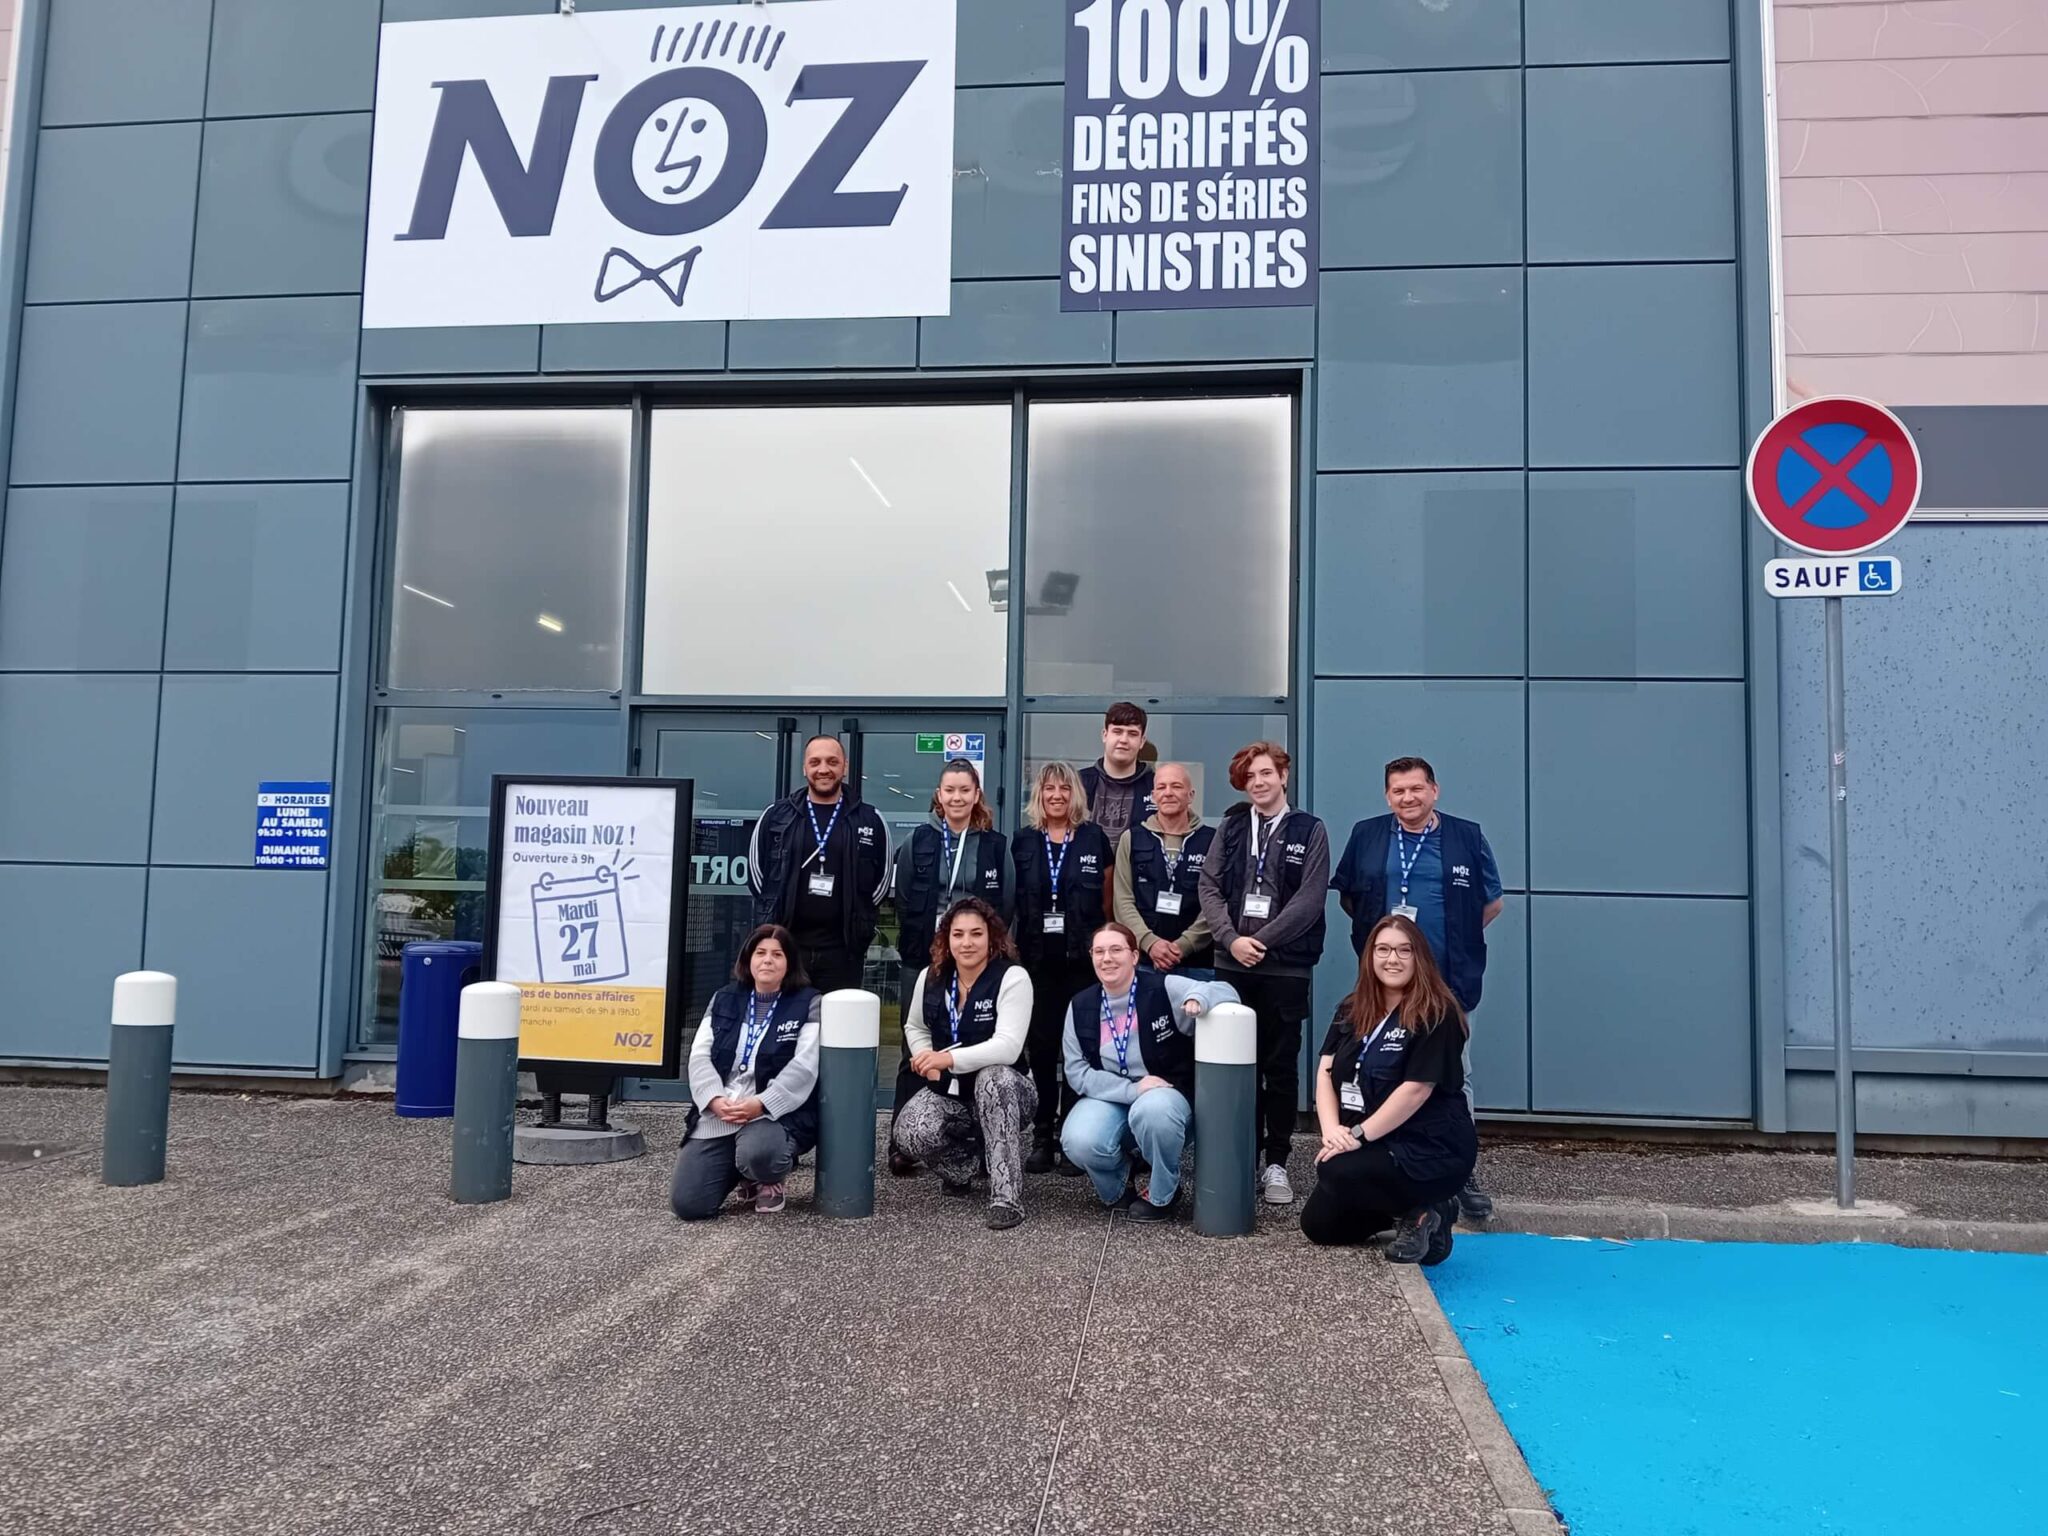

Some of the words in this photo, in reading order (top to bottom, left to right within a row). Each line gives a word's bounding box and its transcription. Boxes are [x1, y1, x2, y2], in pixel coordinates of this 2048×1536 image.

[1074, 0, 1310, 99] 100%
[1073, 98, 1309, 171] DÉGRIFFÉS
[393, 58, 929, 241] NOZ
[1072, 181, 1142, 225] FINS
[1150, 180, 1189, 223] DE
[1196, 171, 1309, 222] SÉRIES
[1068, 227, 1309, 294] SINISTRES
[1774, 566, 1850, 588] SAUF
[275, 796, 327, 804] HORAIRES
[515, 795, 589, 817] Nouveau
[261, 817, 278, 828] AU
[281, 818, 323, 828] SAMEDI
[276, 807, 310, 817] LUNDI
[257, 828, 283, 837] 9h30
[295, 829, 327, 838] 19h30
[514, 824, 587, 846] magasin
[592, 825, 624, 845] NOZ
[262, 845, 320, 855] DIMANCHE
[512, 852, 569, 864] Ouverture
[580, 854, 595, 864] 9h
[558, 901, 599, 922] Mardi
[559, 922, 599, 961] 27
[573, 960, 597, 978] mai
[537, 988, 551, 999] de
[553, 989, 593, 1001] bonnes
[595, 990, 636, 1002] affaires
[614, 1031, 654, 1048] NOZ
